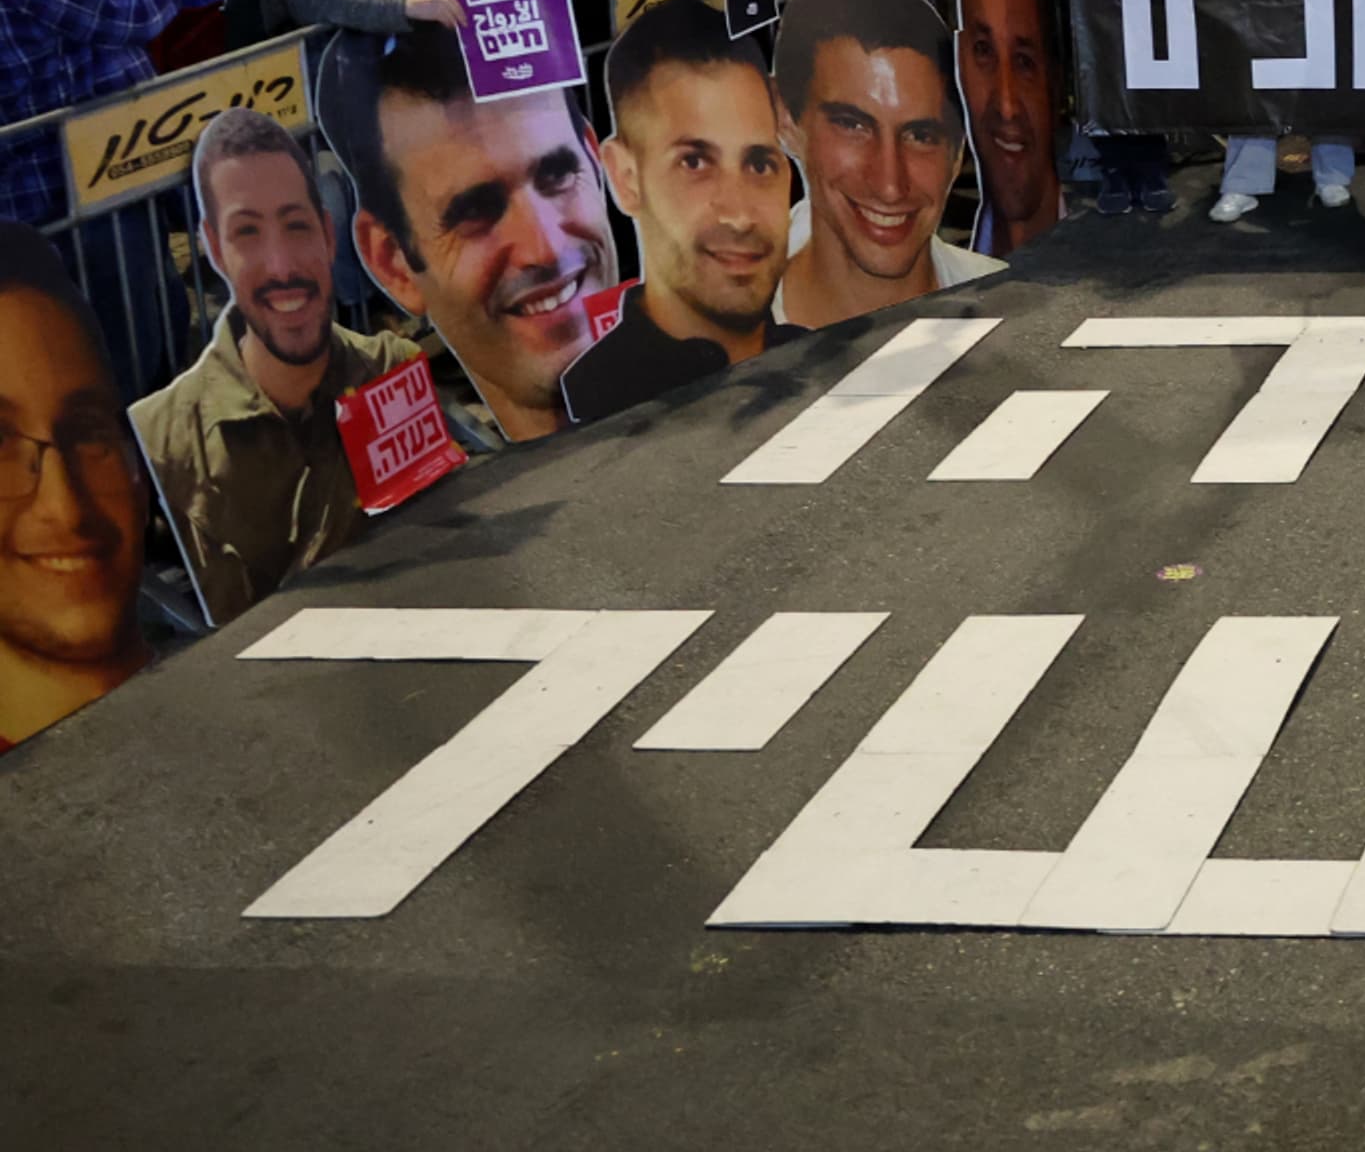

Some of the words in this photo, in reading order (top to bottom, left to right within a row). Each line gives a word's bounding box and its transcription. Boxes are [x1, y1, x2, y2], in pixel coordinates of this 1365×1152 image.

[482, 27, 544, 55] חיים
[370, 365, 428, 430] עדיין
[375, 410, 444, 478] בעזה.
